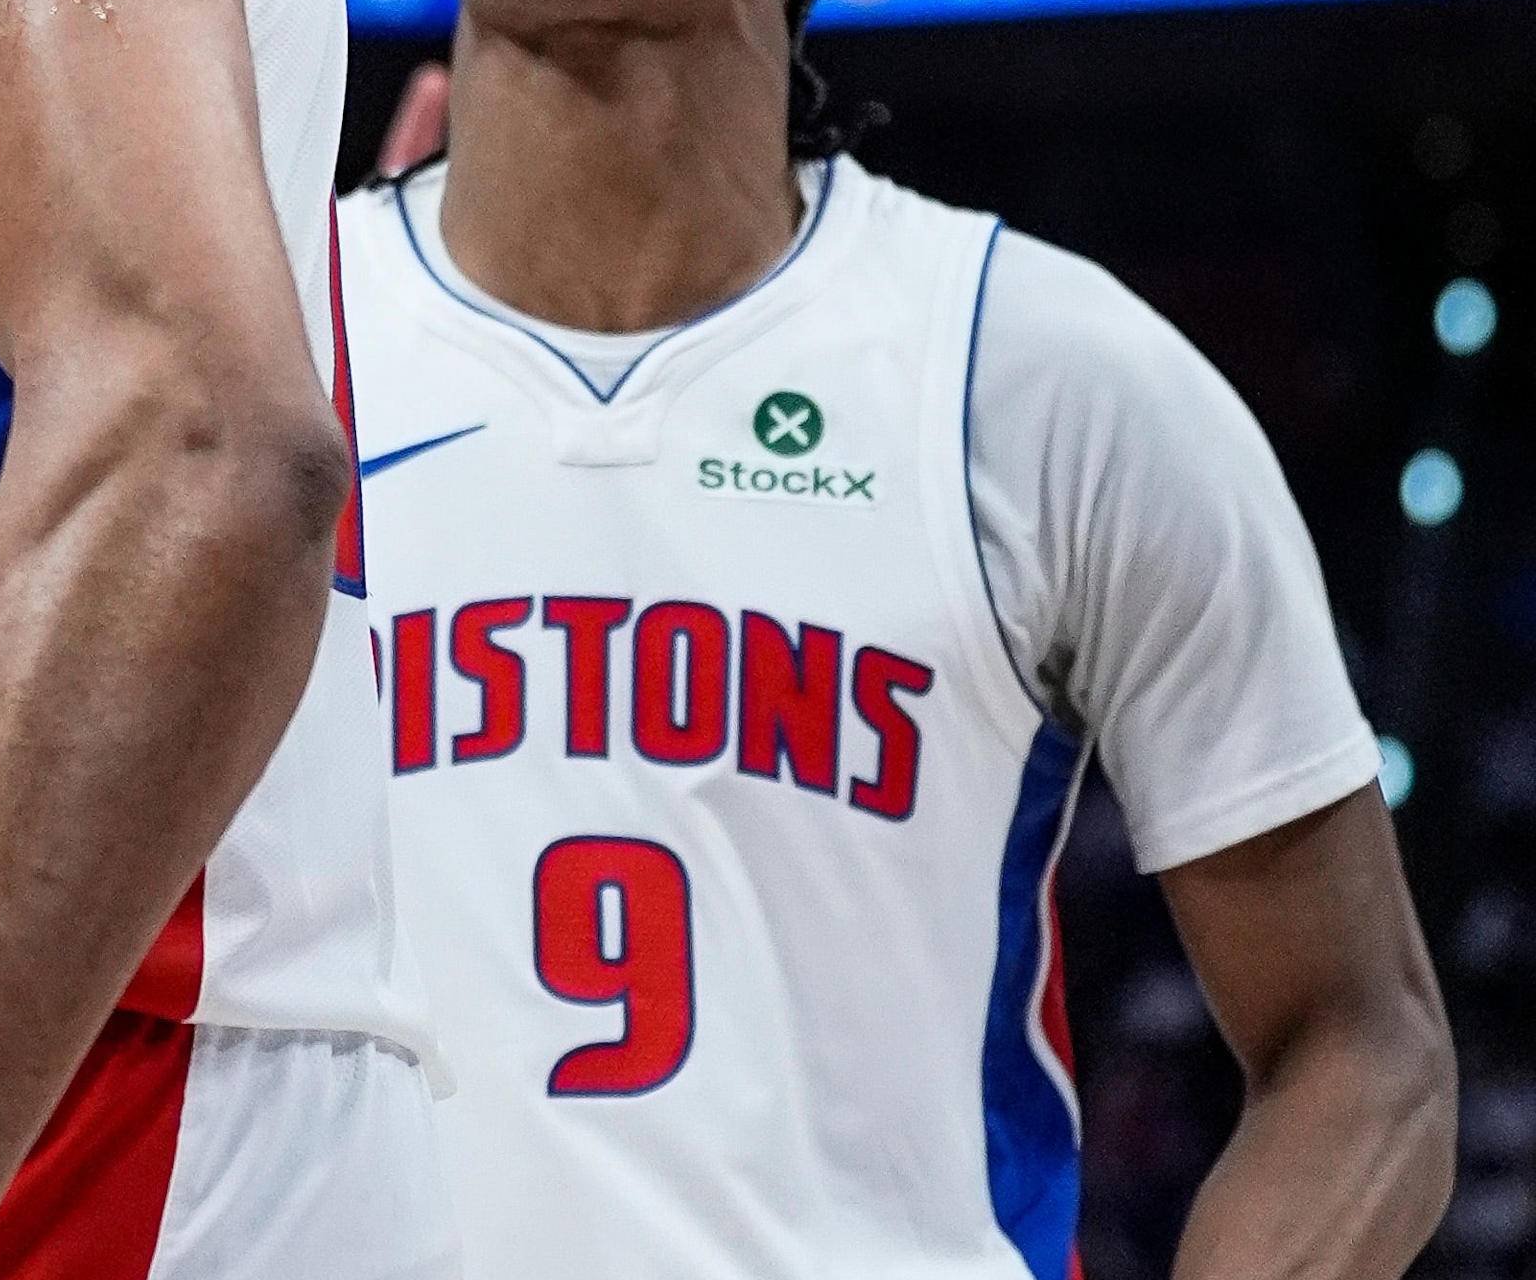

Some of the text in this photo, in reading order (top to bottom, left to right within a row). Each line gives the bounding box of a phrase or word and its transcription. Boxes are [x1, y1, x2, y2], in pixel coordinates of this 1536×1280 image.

[698, 457, 876, 502] StockX
[370, 594, 935, 822] ISTONS
[533, 834, 696, 1098] 9
